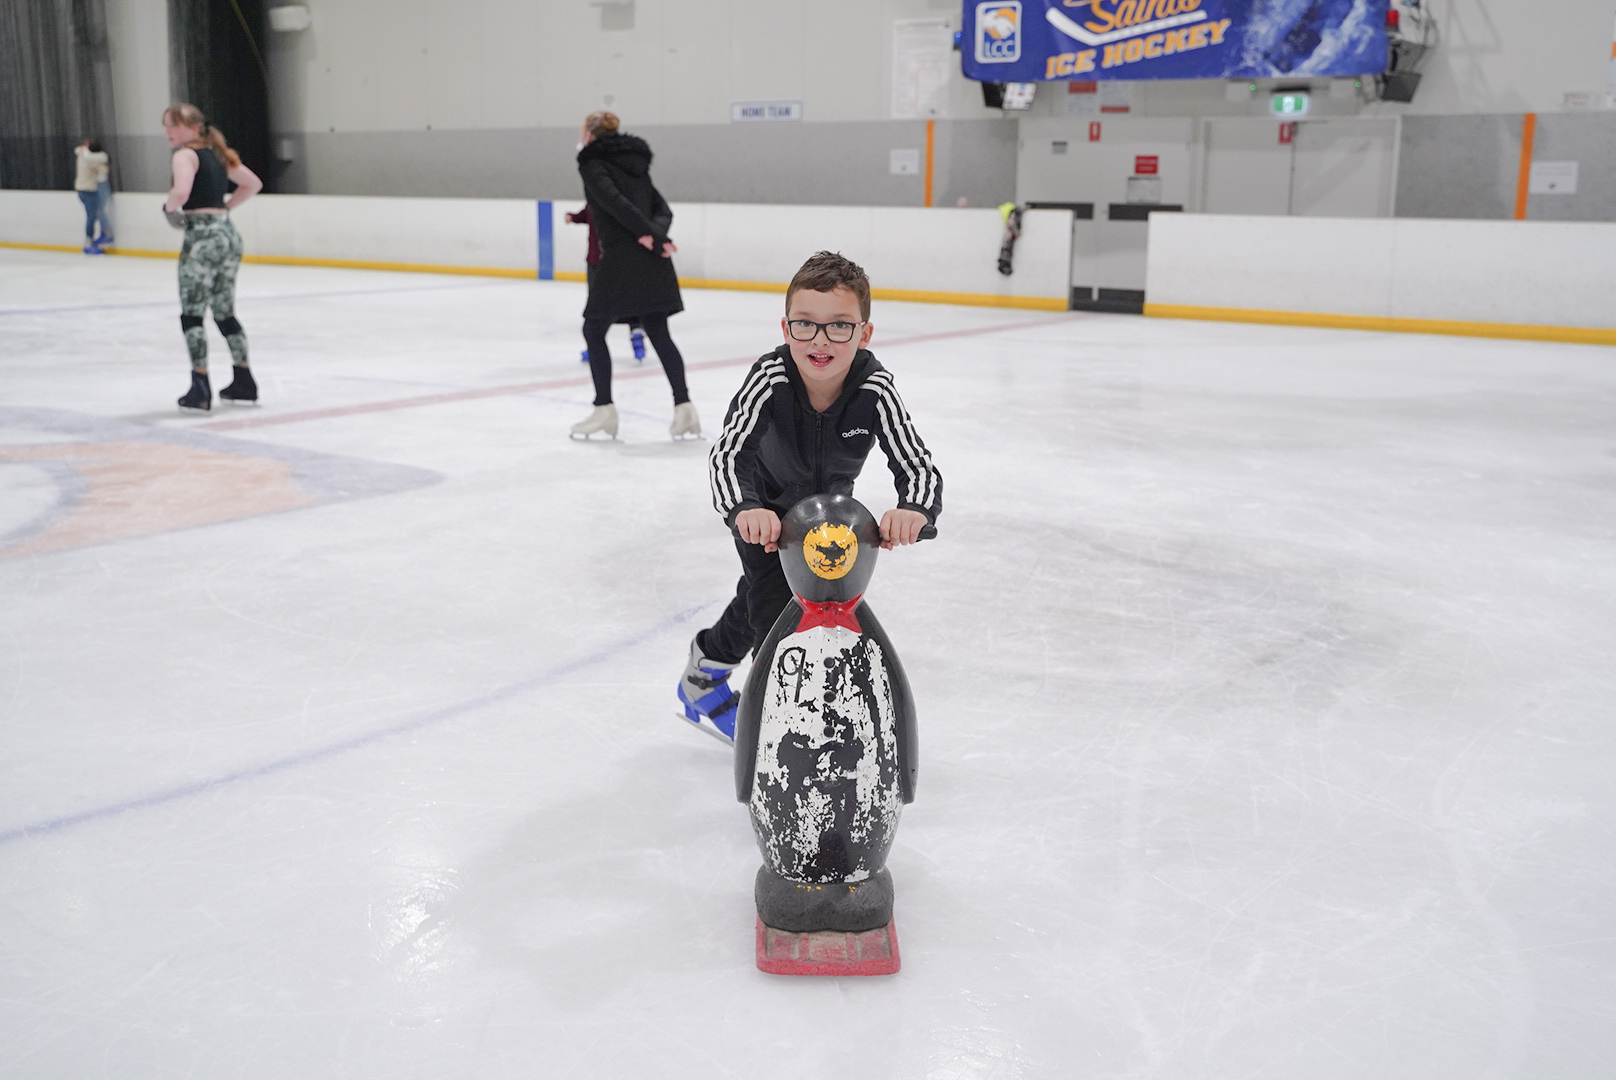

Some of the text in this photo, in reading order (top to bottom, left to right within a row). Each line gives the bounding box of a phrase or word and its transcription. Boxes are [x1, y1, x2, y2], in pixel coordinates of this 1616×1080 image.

[1045, 18, 1232, 79] ICE HOCKEY
[842, 427, 869, 438] adidas
